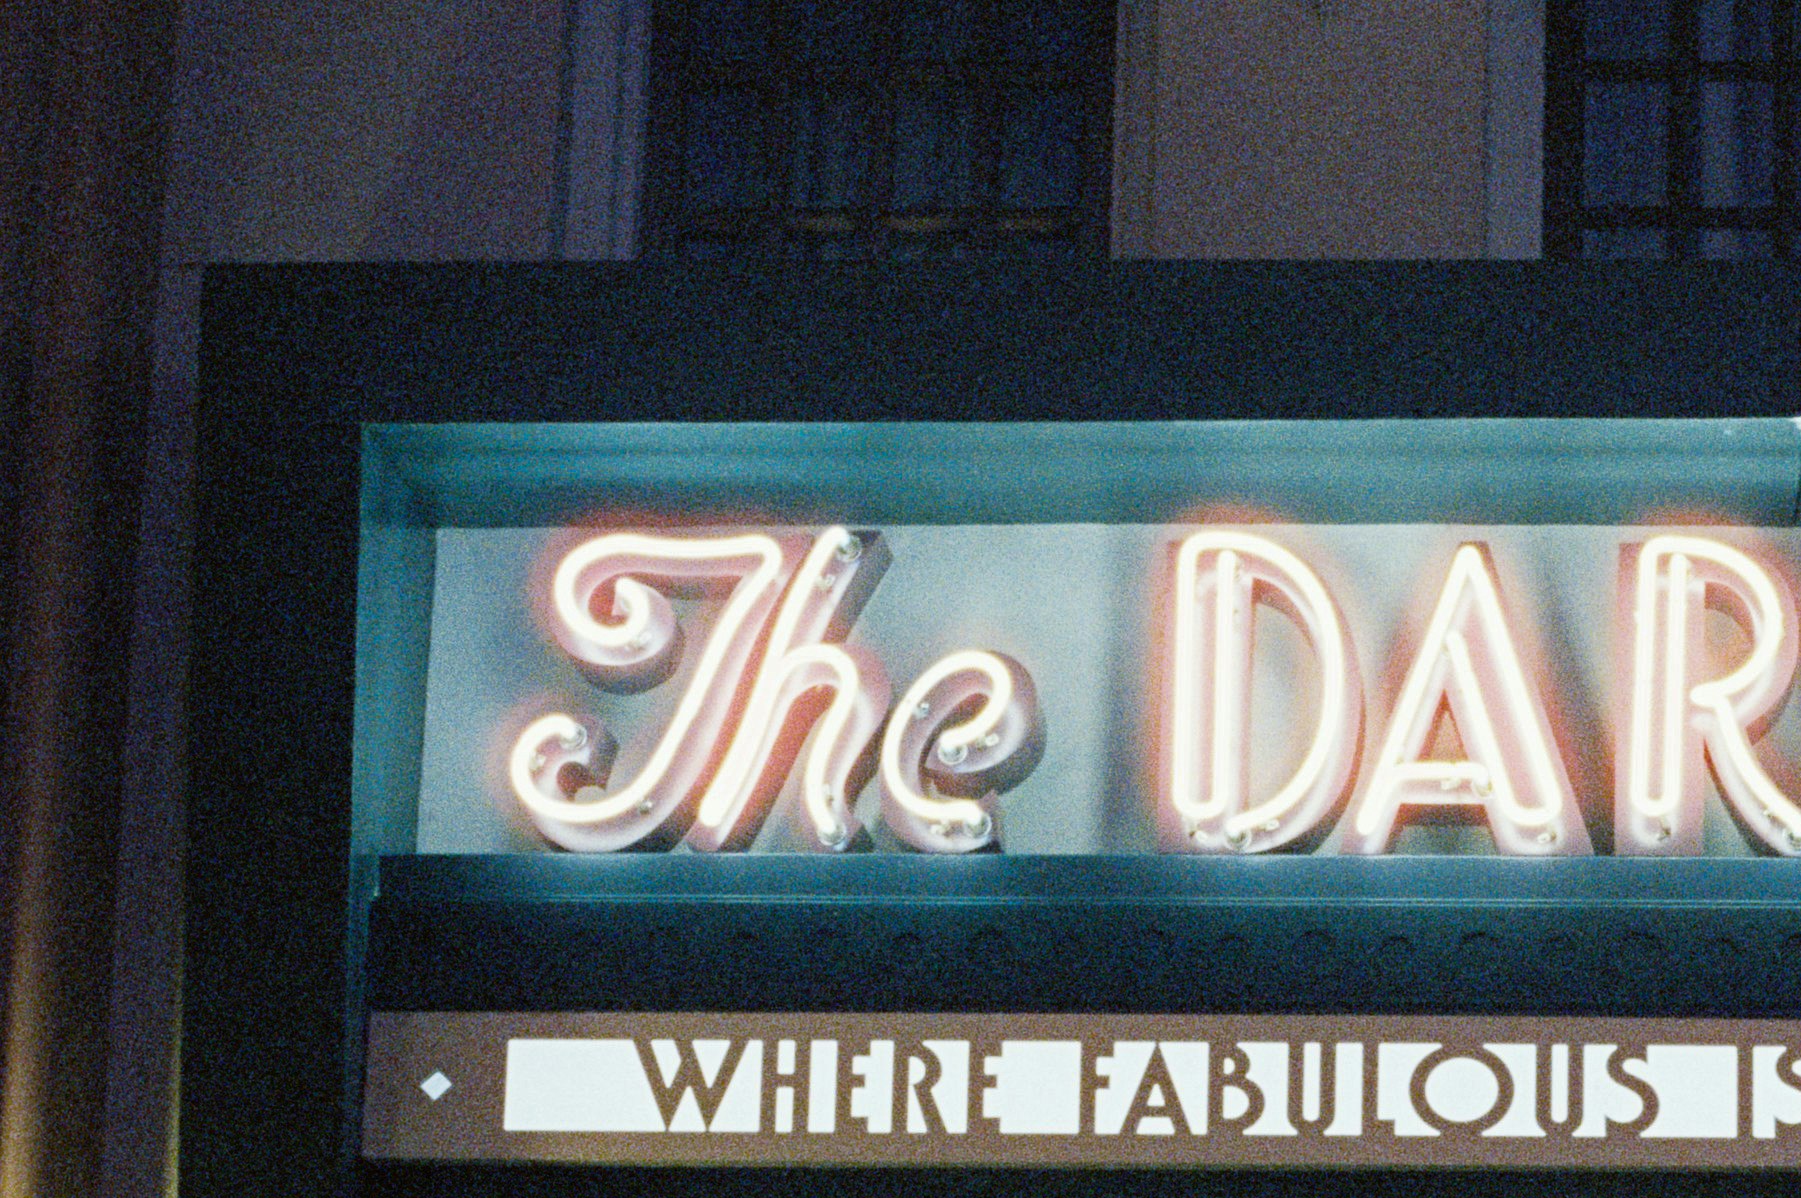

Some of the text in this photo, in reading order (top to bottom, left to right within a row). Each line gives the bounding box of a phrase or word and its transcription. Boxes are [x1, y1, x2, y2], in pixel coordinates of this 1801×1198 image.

[508, 525, 1030, 853] The
[632, 1038, 1000, 1134] WHERE
[1080, 1041, 1661, 1138] FABULOUS
